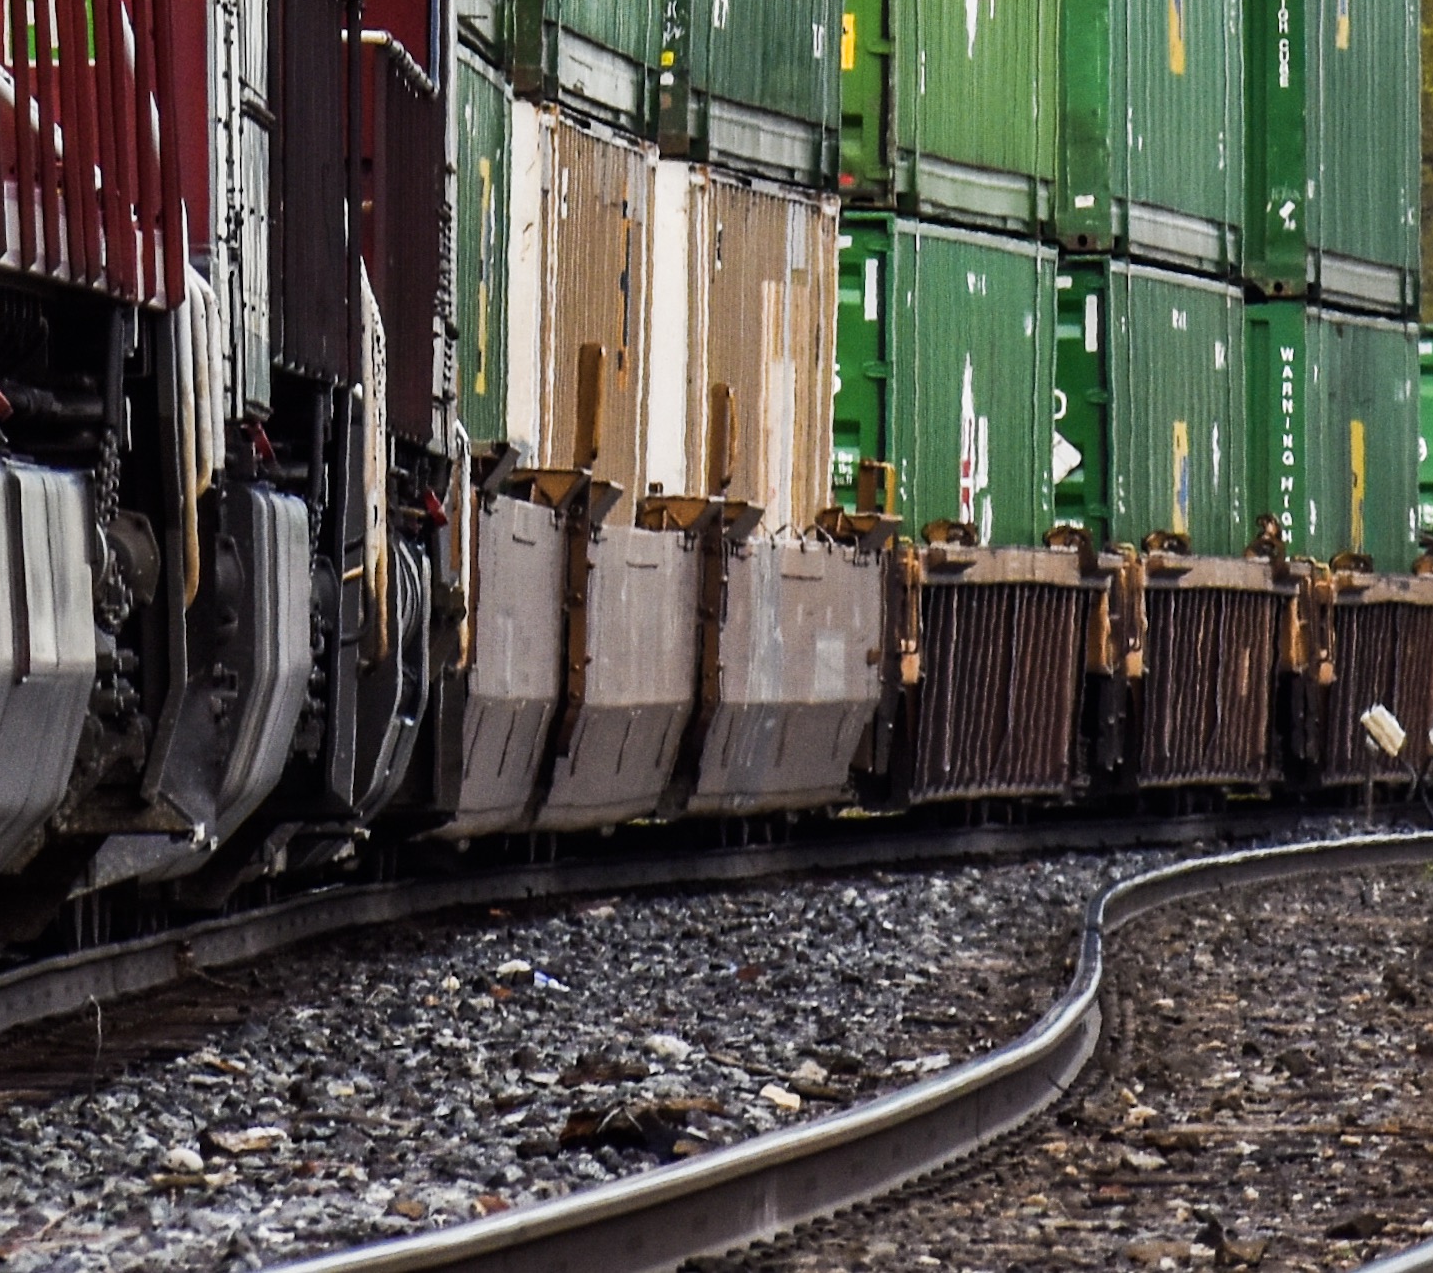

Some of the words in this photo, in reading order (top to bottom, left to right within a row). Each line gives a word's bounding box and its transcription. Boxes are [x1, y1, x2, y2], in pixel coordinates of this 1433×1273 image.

[1279, 37, 1290, 88] CUBE
[1280, 346, 1295, 466] WARNING
[1280, 475, 1293, 544] HIGH
